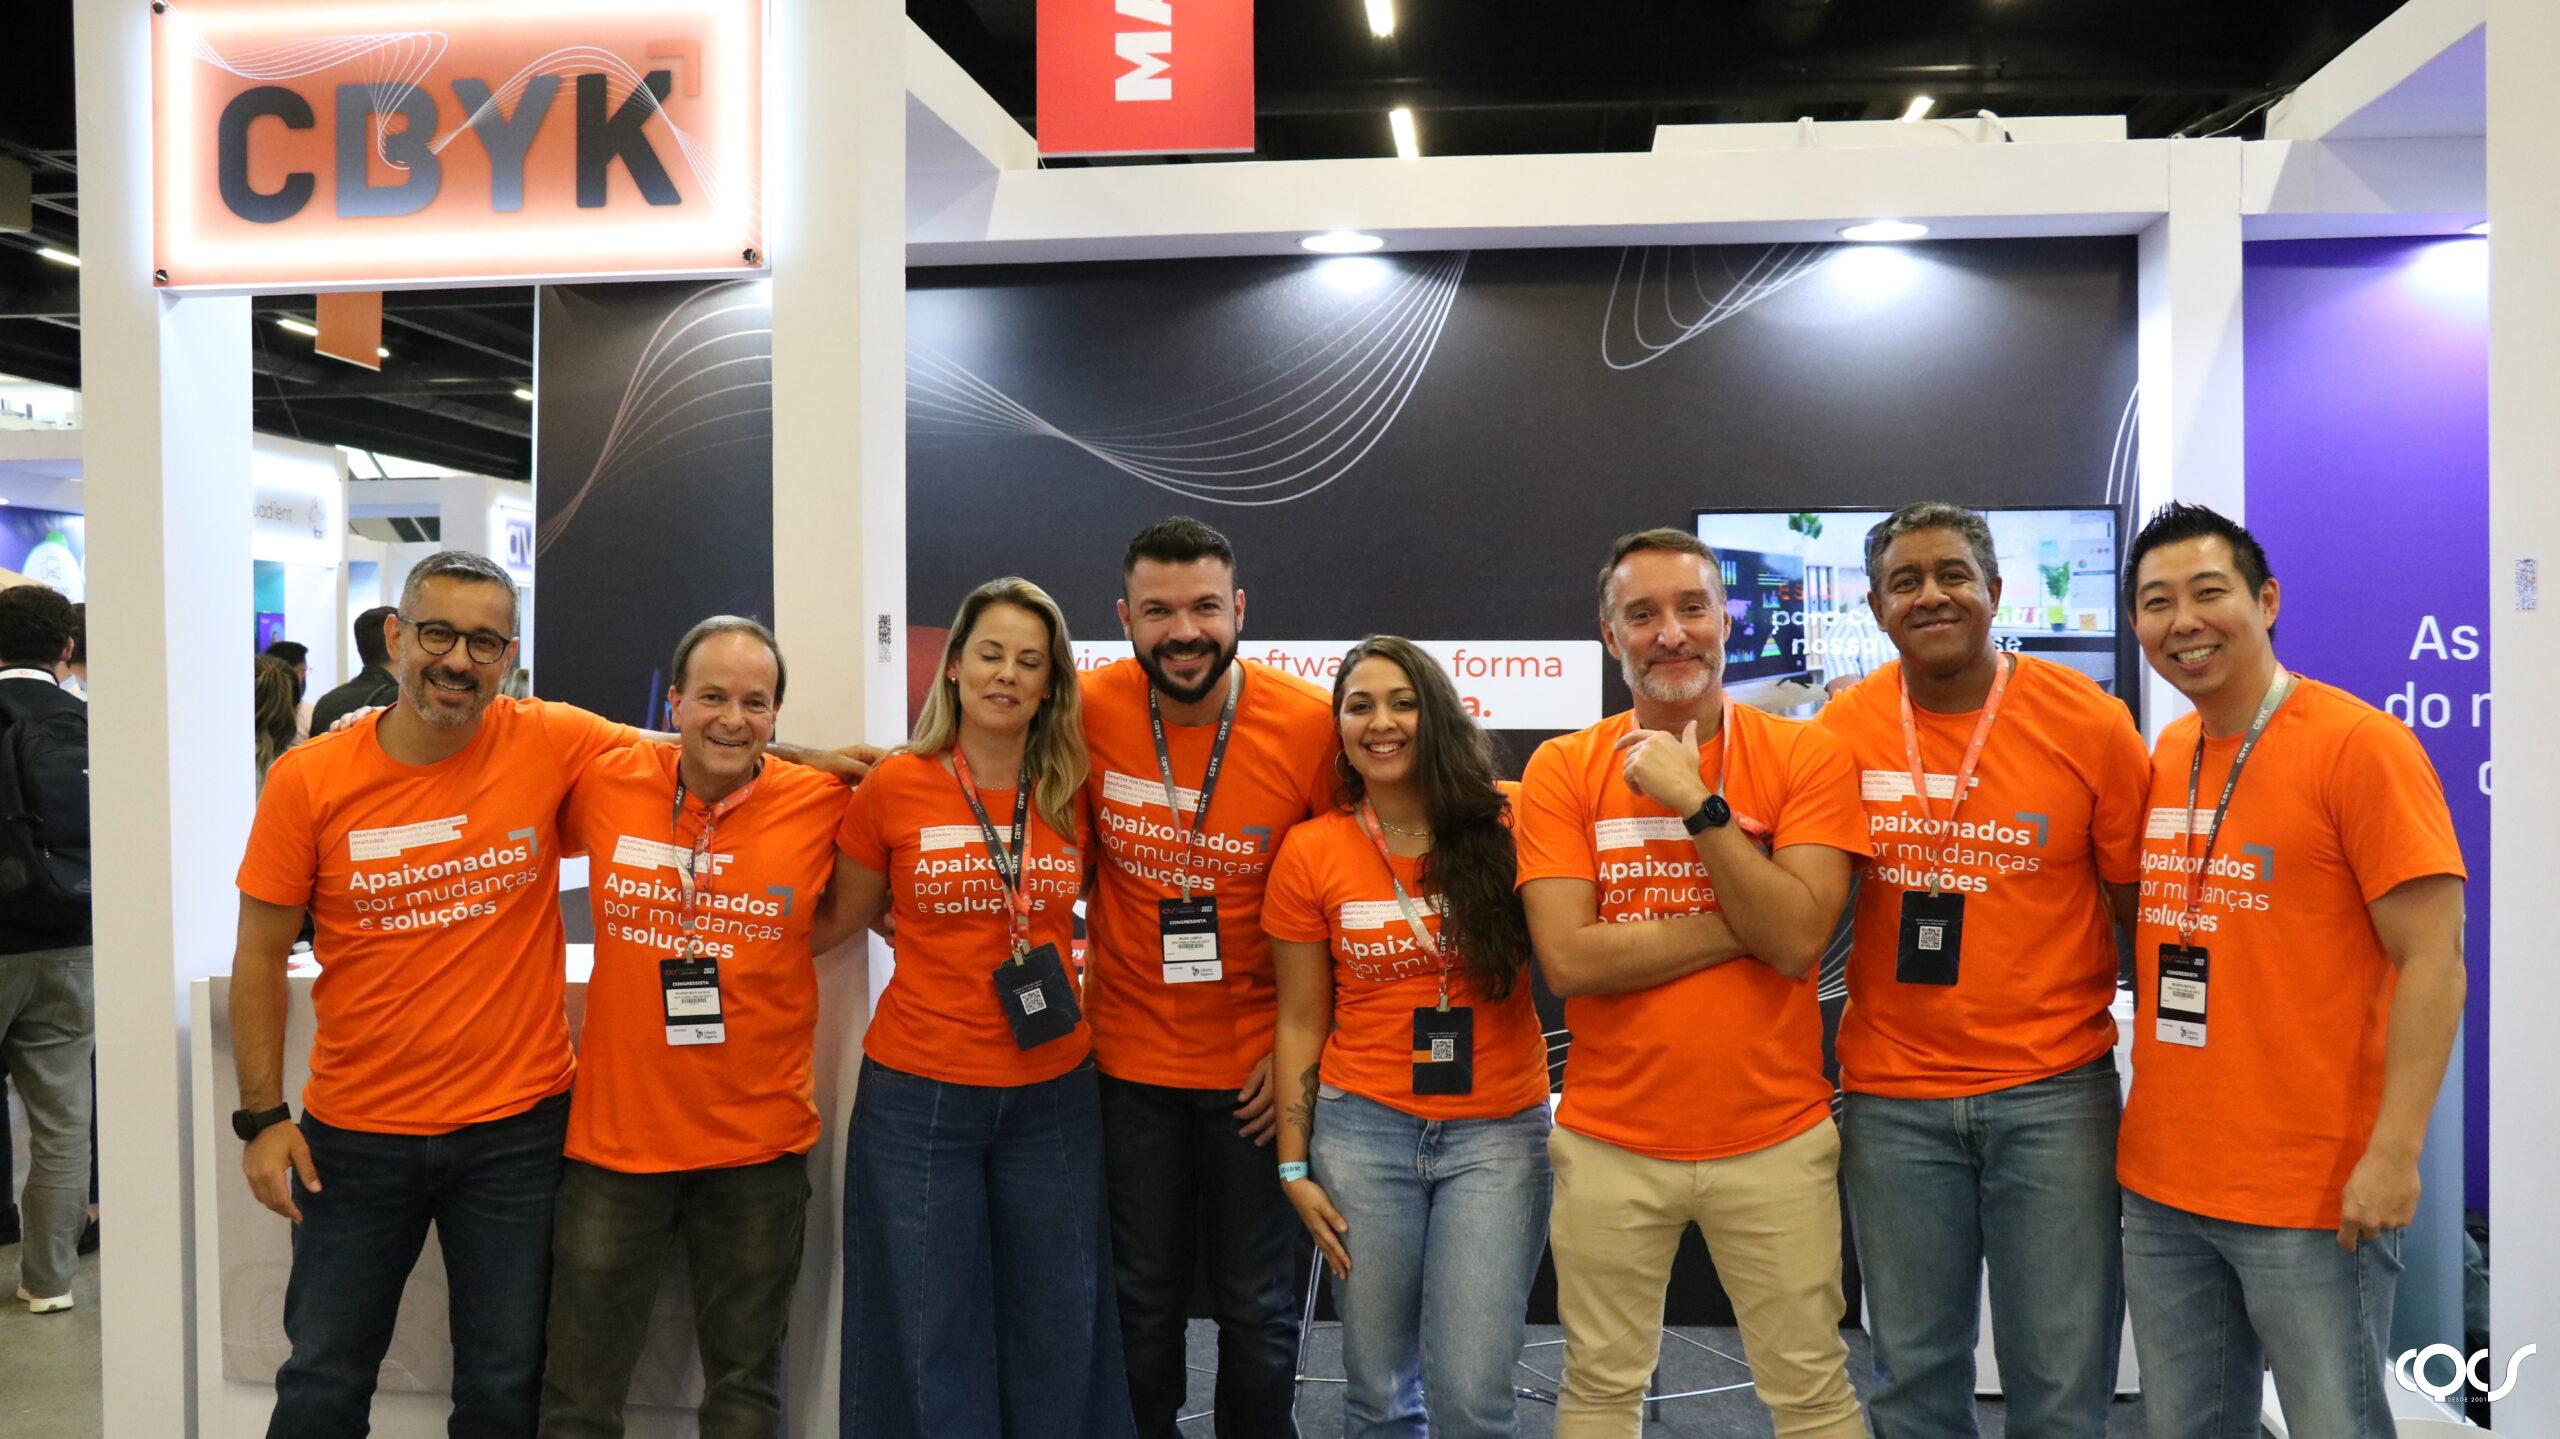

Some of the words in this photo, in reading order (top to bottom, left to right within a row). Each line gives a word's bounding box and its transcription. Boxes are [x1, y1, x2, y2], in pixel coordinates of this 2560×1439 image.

[218, 71, 682, 223] CBYK
[2409, 615, 2480, 660] As
[1453, 649, 1564, 678] forma
[2384, 681, 2451, 728] do
[1218, 721, 1229, 741] CBYK
[2253, 708, 2269, 730] CBYK
[1161, 756, 1169, 776] CBYK
[2237, 742, 2251, 763] CBYK
[1208, 757, 1219, 777] CBYK
[1199, 793, 1208, 813] CBYK
[2221, 782, 2232, 804] CBYK
[1014, 823, 1022, 840] CBYK
[1100, 806, 1255, 854] Apaixonados
[1868, 811, 2030, 846] paixonados
[914, 853, 1076, 878] Apaixados
[995, 854, 1007, 874] CBYK
[1101, 832, 1127, 852] por
[1134, 841, 1263, 876] mudanças
[1898, 842, 2040, 874] mudanças
[349, 845, 528, 894] Apaixonados
[1117, 859, 1215, 890] soluções
[1878, 864, 1988, 893] soluções
[354, 897, 397, 914] por
[406, 867, 538, 907] mudanças
[915, 881, 952, 898] por
[962, 878, 1080, 898] muanças
[2140, 880, 2161, 897] or
[360, 918, 374, 929] e
[381, 900, 497, 930] soluções
[604, 899, 640, 919] por
[917, 902, 928, 913] e
[934, 896, 1046, 914] soluçs
[608, 922, 617, 936] e
[622, 927, 734, 959] soluções
